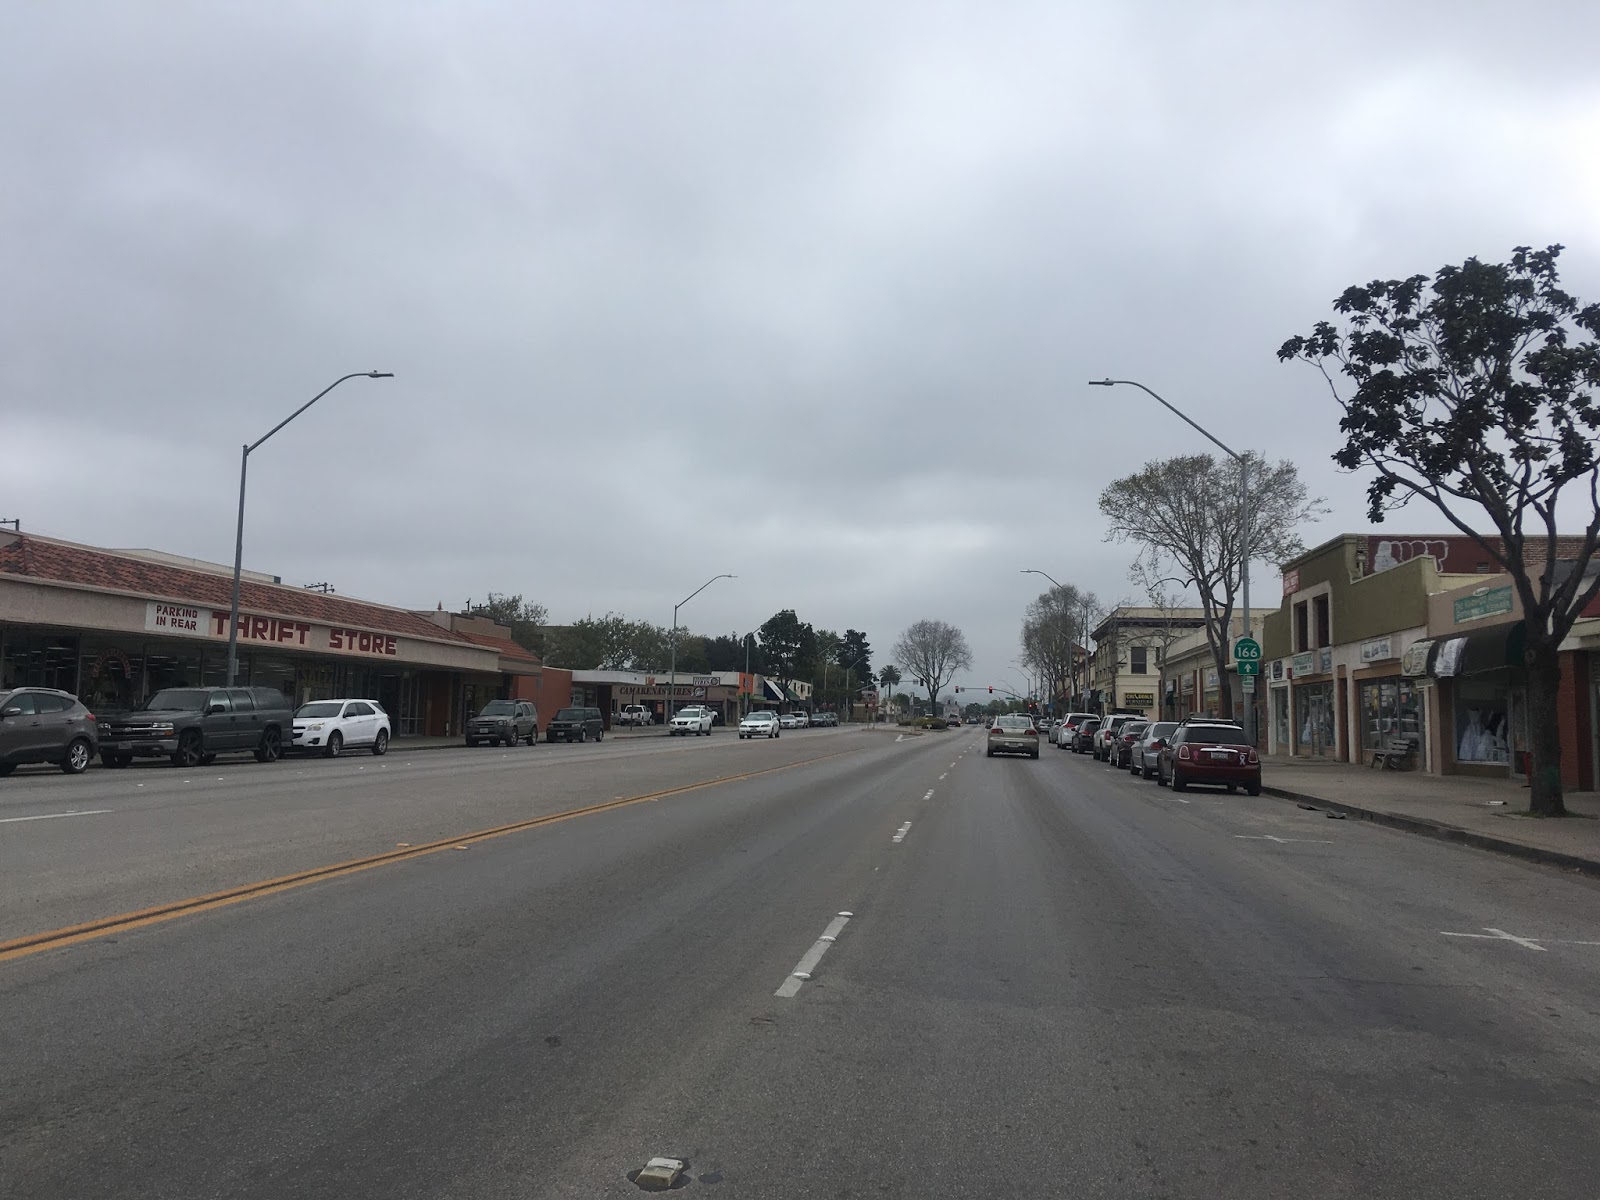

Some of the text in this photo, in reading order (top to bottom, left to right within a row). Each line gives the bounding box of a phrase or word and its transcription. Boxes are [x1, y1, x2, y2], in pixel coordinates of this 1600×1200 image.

[156, 605, 198, 619] PARKING
[156, 616, 197, 631] IN REAR
[212, 611, 398, 655] THRIFT STORE
[1238, 647, 1258, 658] 166
